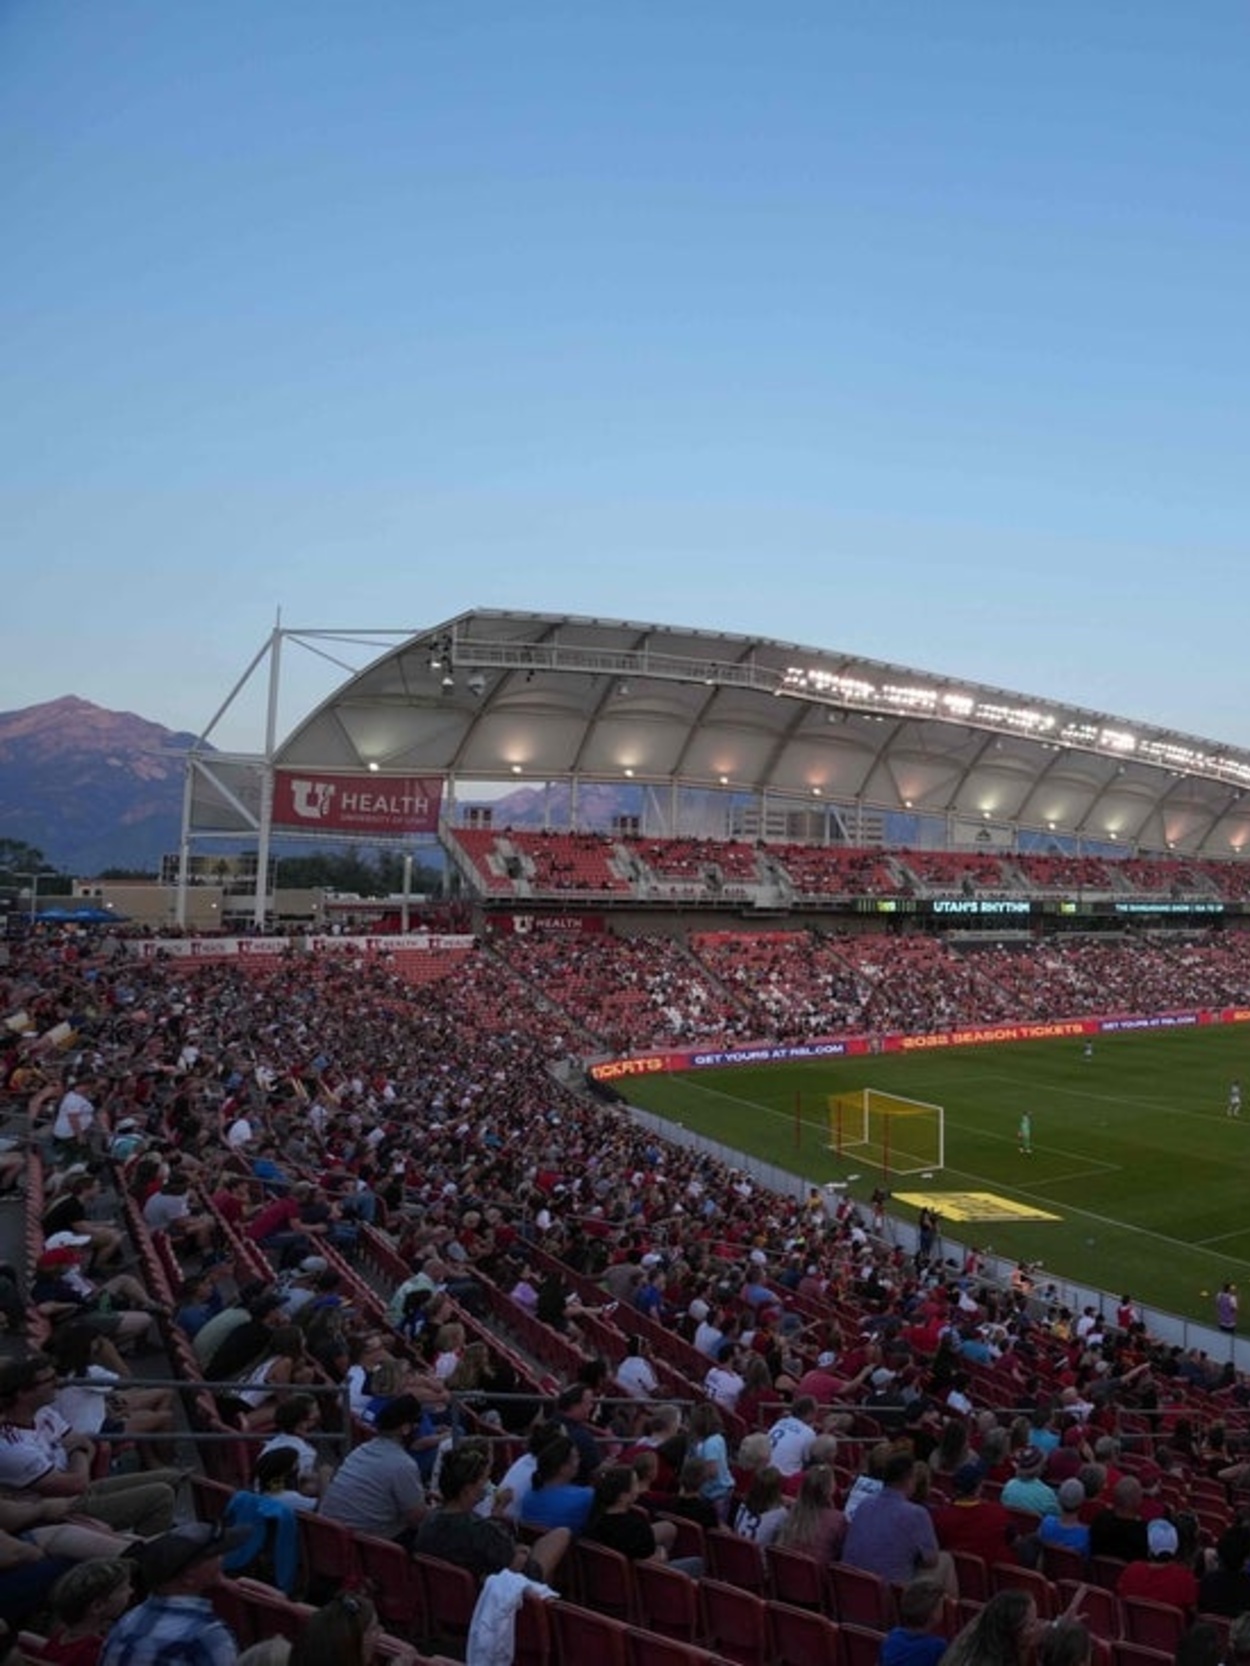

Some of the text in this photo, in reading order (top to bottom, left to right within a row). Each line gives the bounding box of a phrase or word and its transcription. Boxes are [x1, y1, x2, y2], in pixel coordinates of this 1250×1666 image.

[341, 792, 429, 814] HEALTH
[933, 901, 1030, 912] UTAH'S RHYTHM
[536, 918, 582, 928] HEALTH
[952, 1029, 1017, 1044] SEASON
[1020, 1024, 1083, 1037] TICKETS
[695, 1044, 844, 1065] GET YOURS AT RSL.COM
